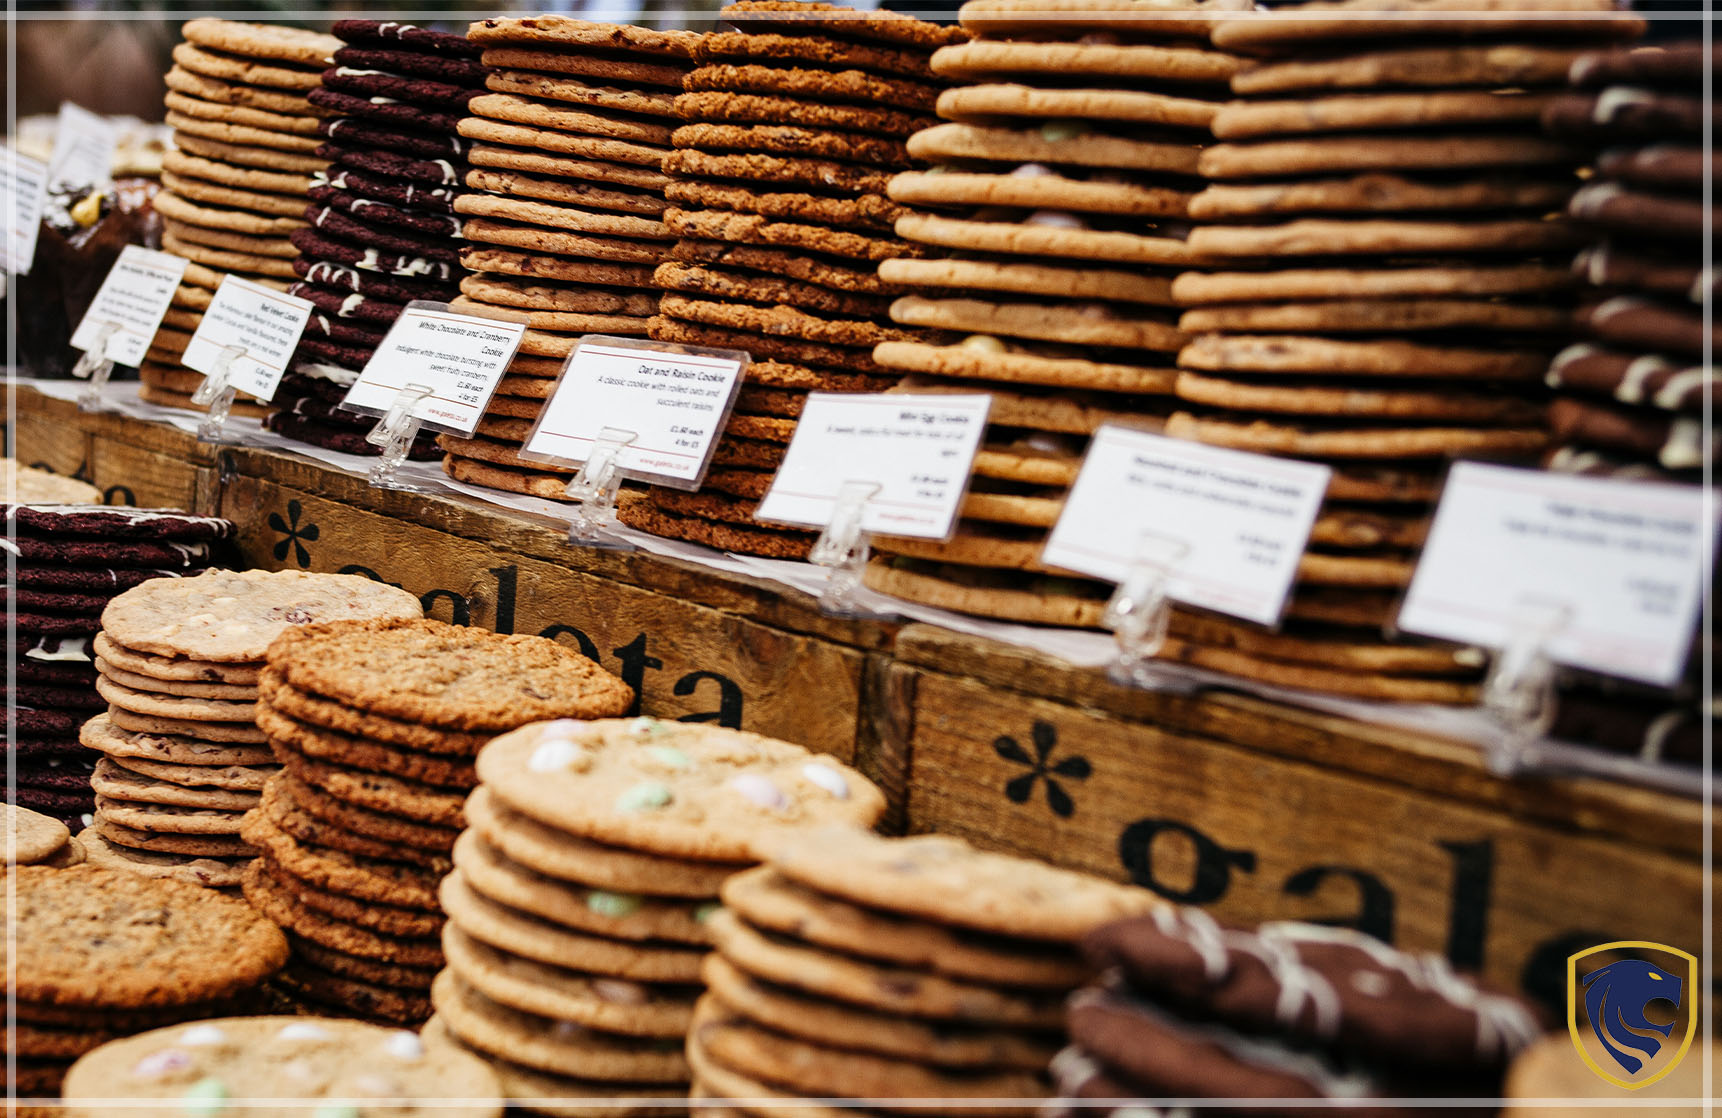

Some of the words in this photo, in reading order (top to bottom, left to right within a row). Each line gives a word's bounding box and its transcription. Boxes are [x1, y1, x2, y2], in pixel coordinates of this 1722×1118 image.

[418, 320, 436, 331] White
[437, 324, 466, 336] Chocolate
[467, 328, 480, 338] and
[480, 330, 512, 344] Cranberry
[482, 346, 504, 358] Cookie
[420, 350, 434, 358] white
[434, 352, 460, 362] chocolate
[460, 356, 484, 368] bursting
[484, 361, 497, 370] with
[638, 364, 653, 374] Oat
[654, 366, 671, 377] and
[672, 368, 696, 380] Raisin
[698, 370, 726, 383] Cookie
[604, 376, 626, 386] classic
[626, 379, 650, 390] cookie
[650, 382, 666, 391] with
[668, 384, 689, 394] rolled
[689, 388, 704, 396] oats
[705, 389, 720, 398] and
[656, 398, 691, 410] succulent
[692, 402, 714, 412] raisins
[921, 412, 936, 424] Egg
[688, 428, 704, 436] each
[681, 439, 689, 447] for
